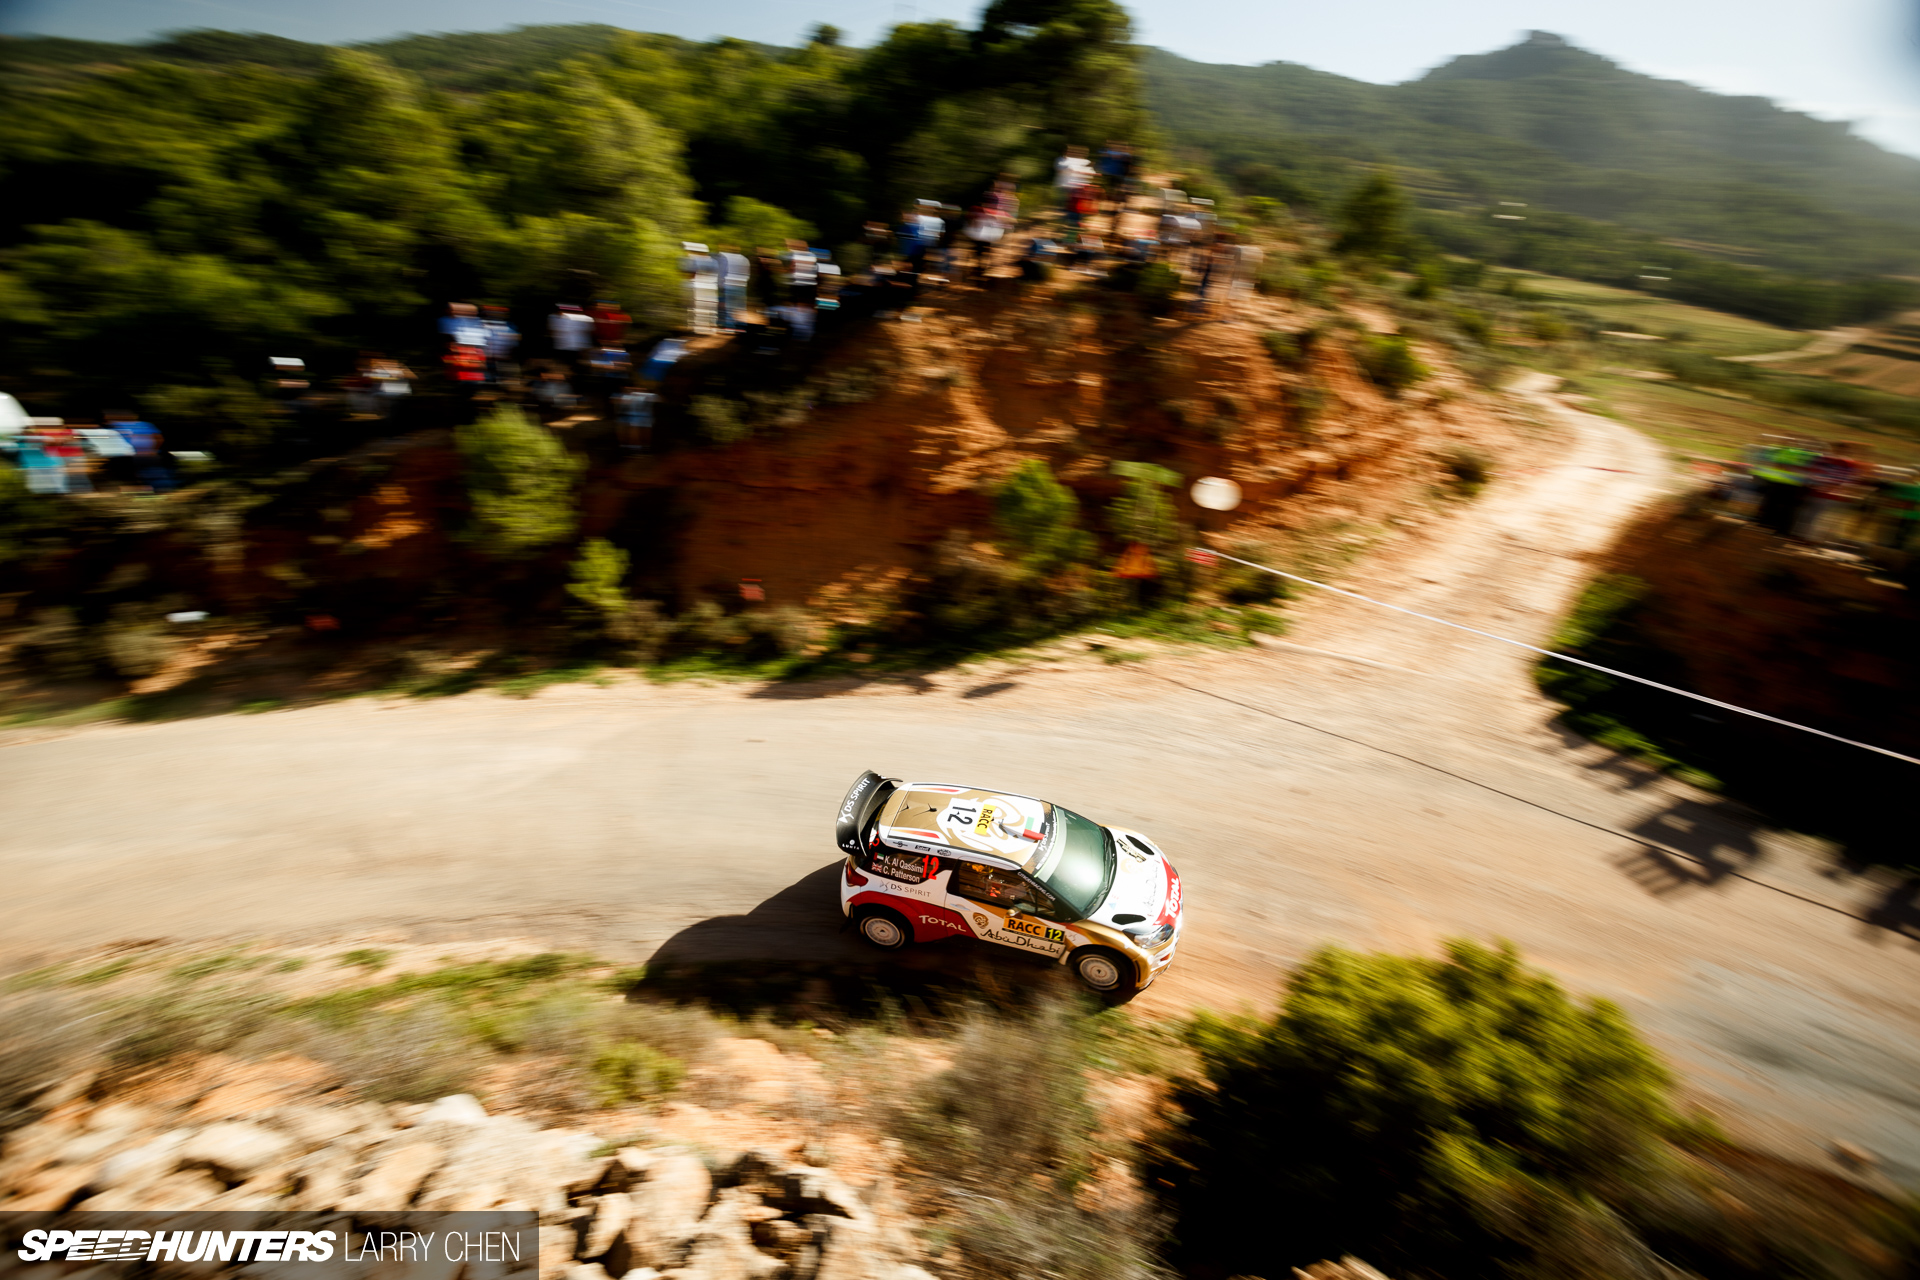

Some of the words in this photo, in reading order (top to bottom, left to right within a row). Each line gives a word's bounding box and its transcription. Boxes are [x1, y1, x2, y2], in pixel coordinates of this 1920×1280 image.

[844, 800, 855, 812] DS
[850, 778, 870, 800] SPIRIT
[947, 806, 976, 825] 12
[977, 808, 993, 829] RACC
[883, 866, 890, 875] C.
[891, 867, 920, 883] Patterson
[884, 856, 891, 865] K.
[899, 859, 924, 874] Qassimi
[922, 855, 939, 880] 12
[890, 883, 902, 891] DS
[904, 887, 931, 898] SPIRIT
[1165, 878, 1180, 918] TOTAL
[919, 915, 967, 932] TOTAL
[1007, 919, 1041, 935] RACC
[1048, 928, 1062, 941] 12
